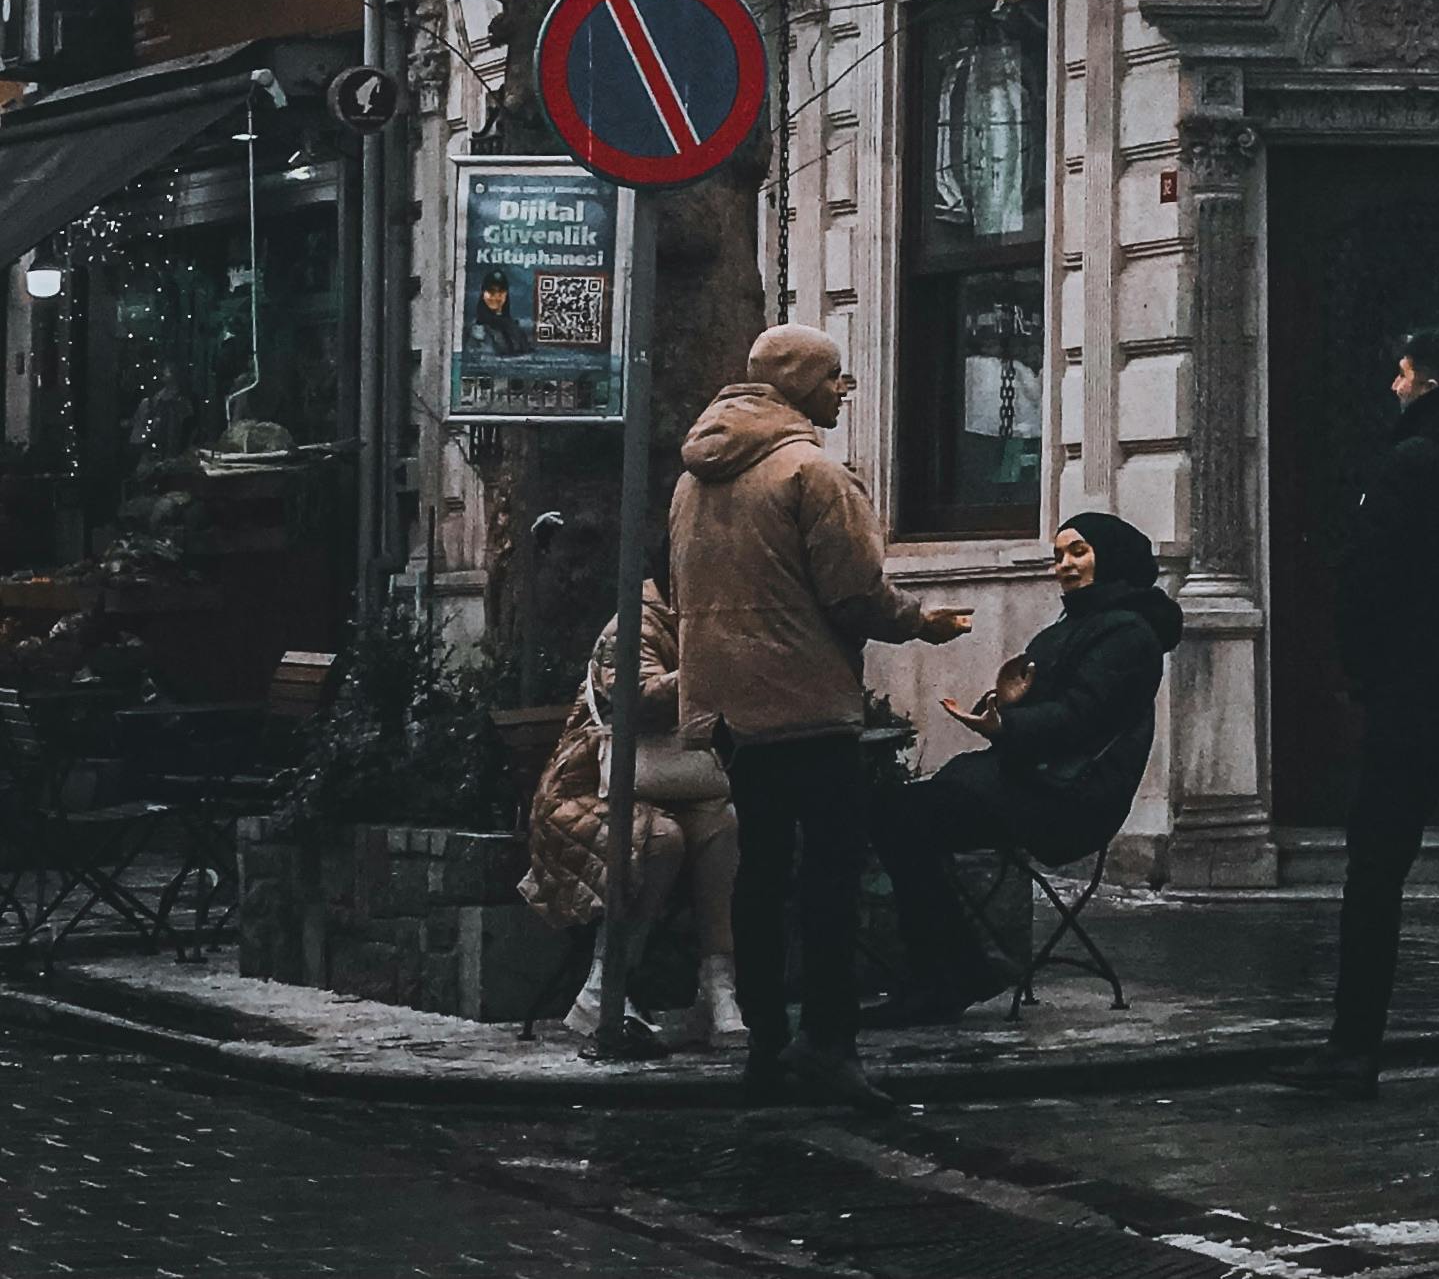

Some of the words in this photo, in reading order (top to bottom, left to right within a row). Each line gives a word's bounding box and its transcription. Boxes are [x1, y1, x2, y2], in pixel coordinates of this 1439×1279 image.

[499, 199, 584, 226] Dijital
[482, 224, 598, 246] Güvenlik
[476, 247, 604, 269] Kütüphanesi
